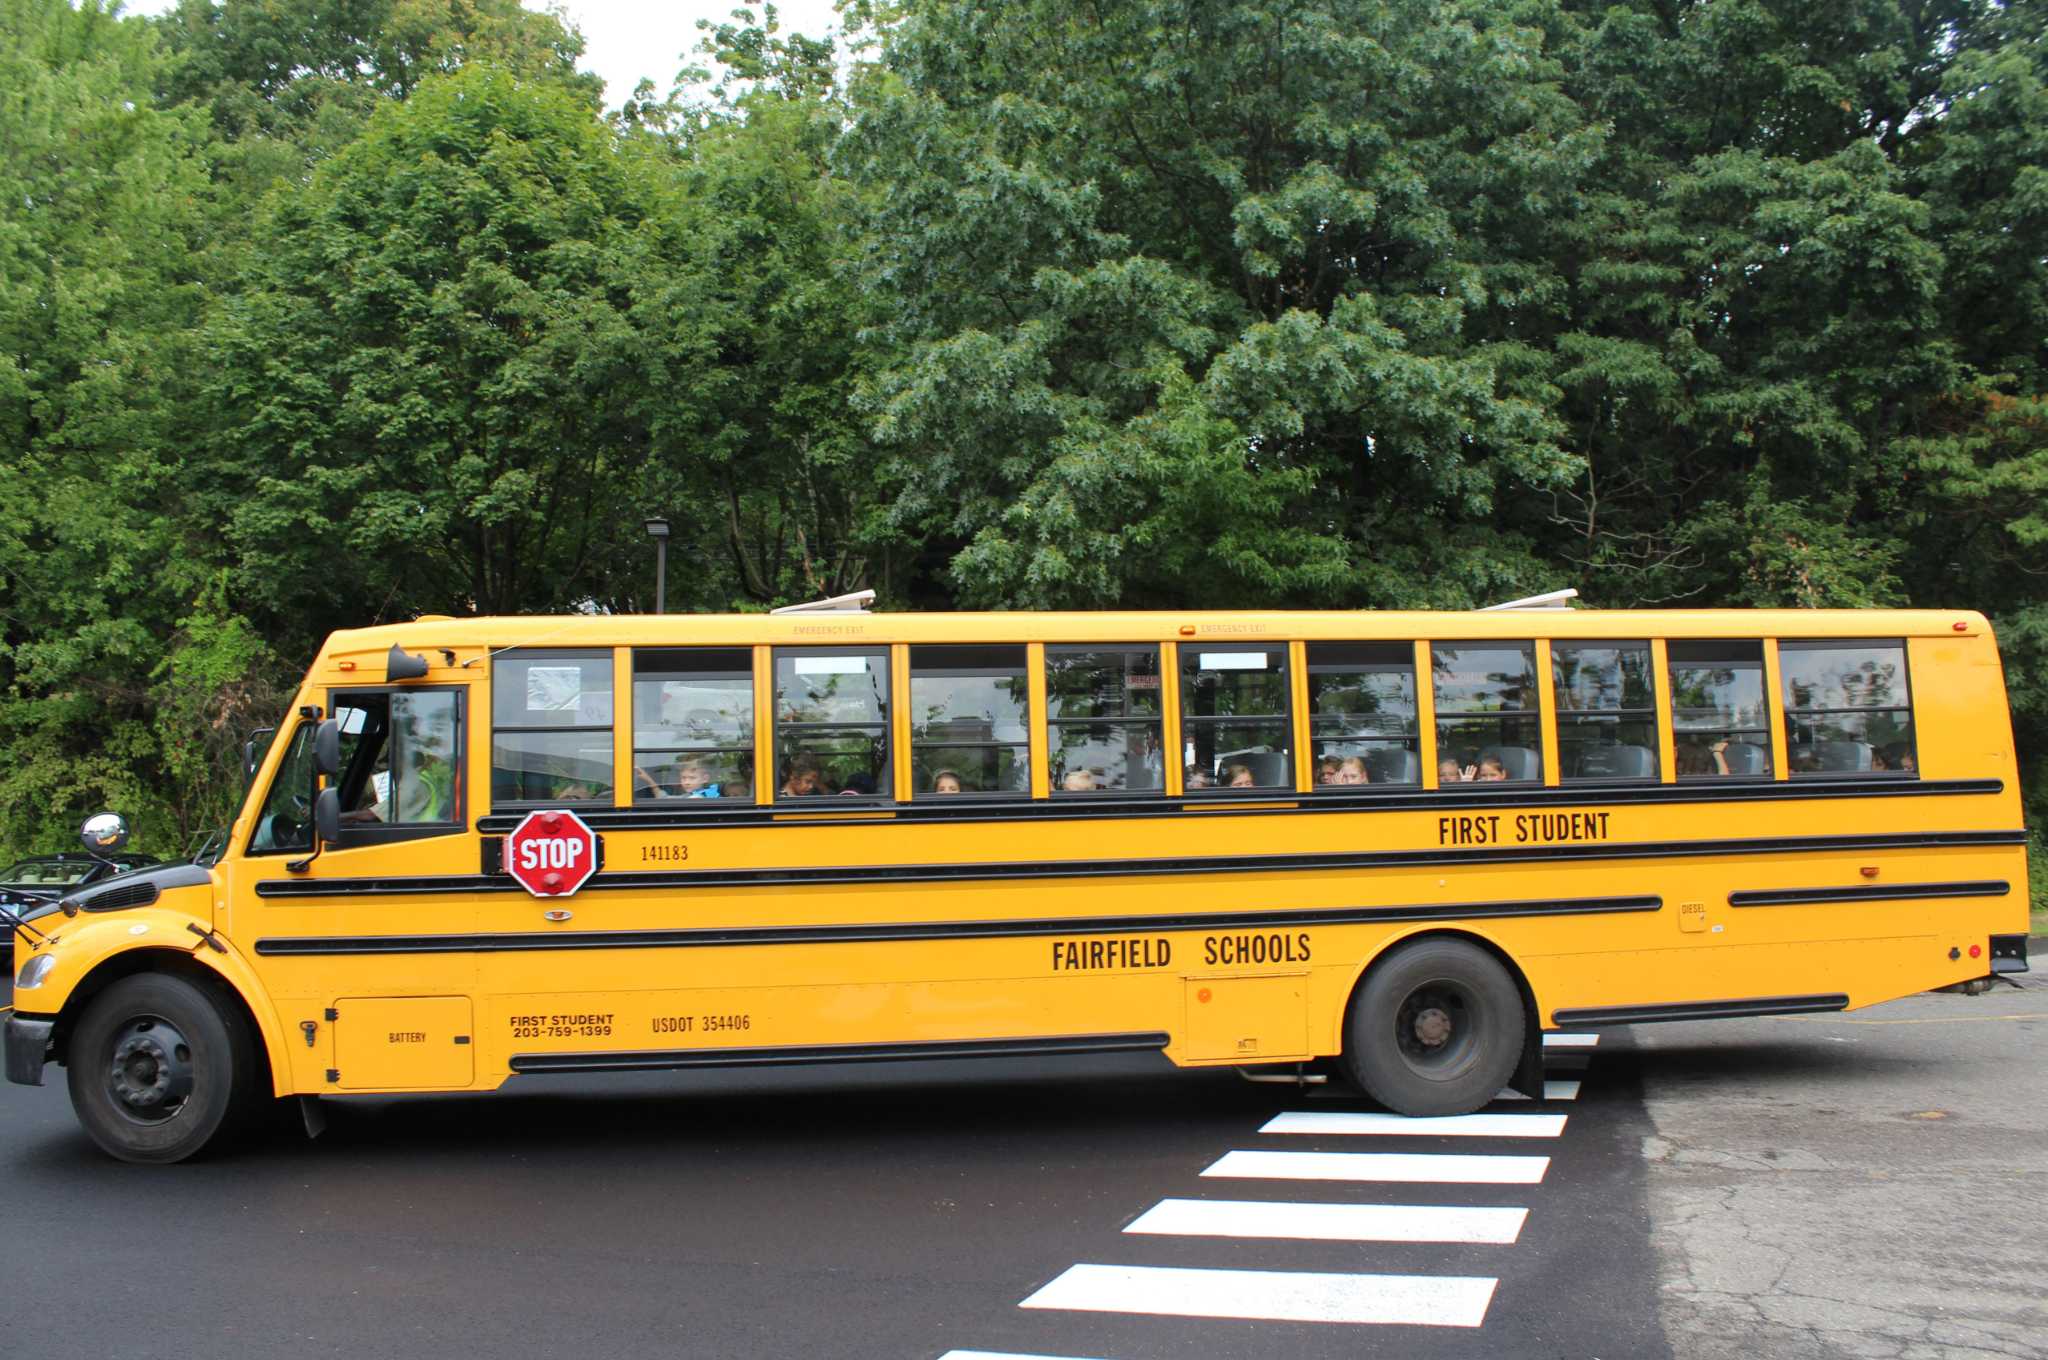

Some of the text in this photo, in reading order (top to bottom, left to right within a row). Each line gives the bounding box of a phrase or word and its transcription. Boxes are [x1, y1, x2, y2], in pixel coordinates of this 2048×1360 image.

[1439, 812, 1610, 845] FIRST STUDENT
[520, 838, 584, 870] STOP
[641, 845, 689, 861] 141183
[1681, 903, 1707, 914] DIESEL
[1053, 933, 1311, 971] FAIRFIELD SCHOOLS
[510, 1013, 614, 1027] FIRST STUDENT
[652, 1014, 750, 1033] USDOT 354406
[389, 1031, 426, 1044] BATTERY
[513, 1025, 612, 1038] 203-759-1399
